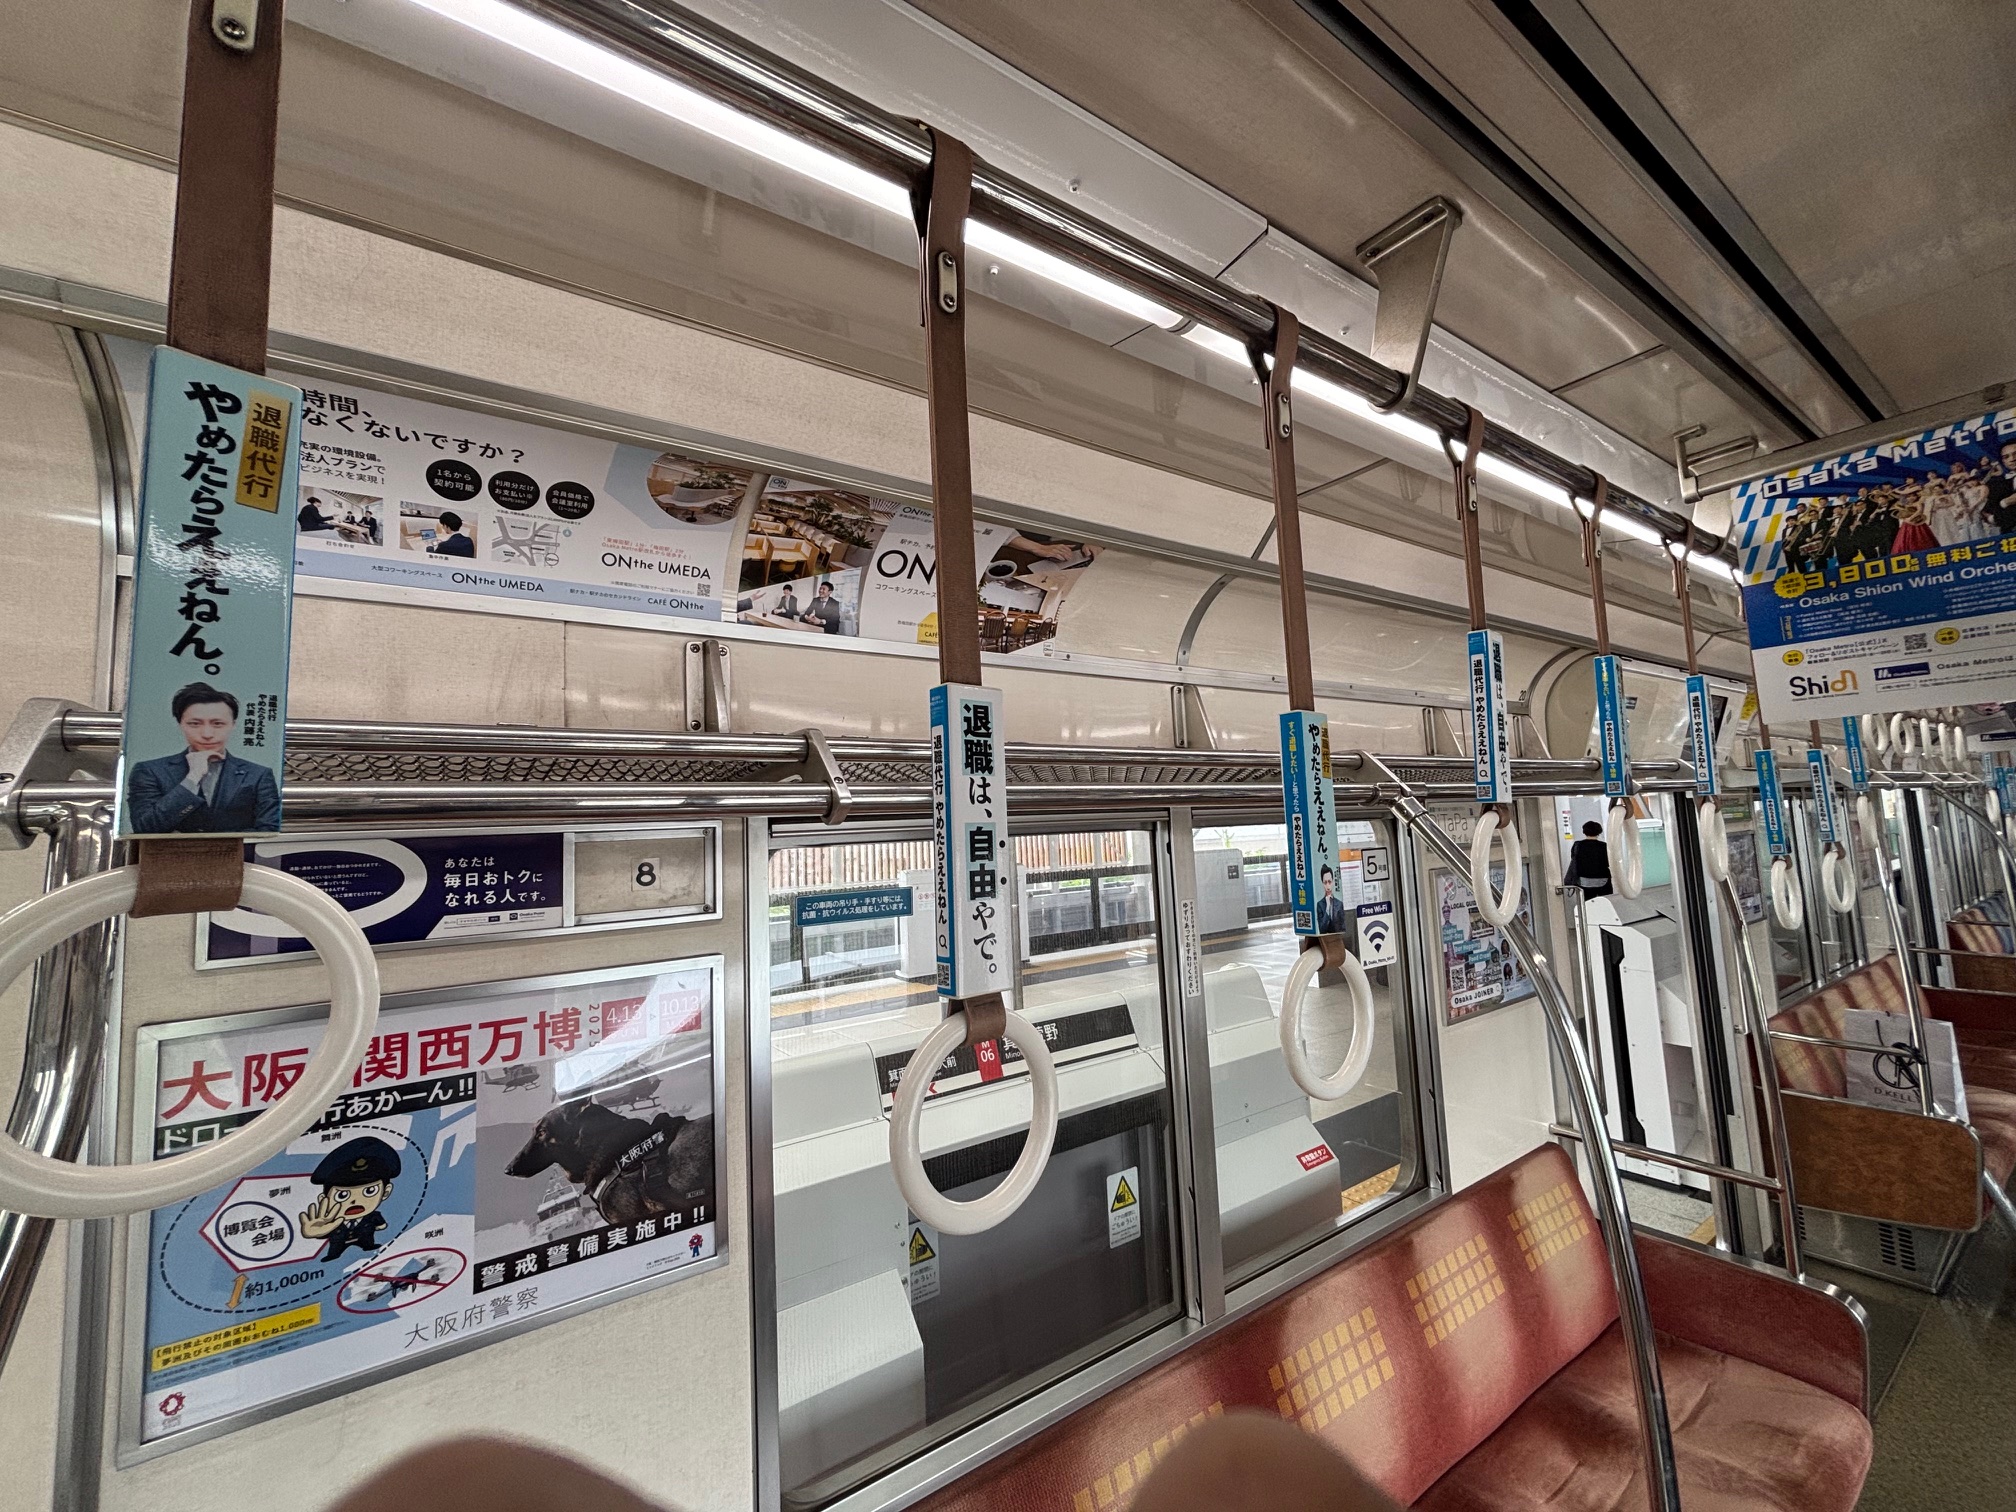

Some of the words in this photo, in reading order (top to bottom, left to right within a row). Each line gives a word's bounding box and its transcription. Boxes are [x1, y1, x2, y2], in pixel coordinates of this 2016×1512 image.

[242, 402, 283, 498] 退職代行
[437, 468, 472, 481] 1名から
[495, 479, 535, 491] 利用分だけ
[1762, 455, 1879, 499] Osaka
[433, 478, 475, 493] 契約可能
[552, 489, 589, 501] 会員価格で
[371, 565, 443, 578] 大型コワーキングスペース
[658, 561, 711, 579] UMEDA
[499, 578, 544, 592] UMEDA
[1799, 592, 1850, 608] Osaka
[1854, 582, 1903, 598] Shion
[1908, 571, 1954, 588] Wind
[1473, 659, 1484, 694] 退職代行
[1475, 696, 1488, 765] やめたらええねん
[933, 734, 944, 795] 退職代行
[1307, 723, 1328, 860] やめたらええねん。
[963, 703, 998, 974] 退職は、自由やで。
[1293, 816, 1305, 879] やめたらええねん
[444, 856, 495, 869] あなたは
[935, 801, 948, 925] やめたらええねん
[443, 869, 543, 888] 毎日おトクに
[636, 862, 656, 887] 8
[444, 888, 546, 907] なれる人です。
[1361, 906, 1374, 915] Free
[1373, 904, 1388, 913] Wi-Fi
[1182, 902, 1194, 995] ゆずりあっておすわりください
[1454, 993, 1473, 1005] Osaka
[606, 1004, 642, 1024] 4.13
[161, 1008, 582, 1119] 大阪関西万博
[980, 1050, 995, 1063] 06
[268, 1186, 291, 1198] 夢洲
[223, 1215, 275, 1238] 博覧会
[251, 1228, 286, 1247] 会場
[244, 1269, 325, 1299] 約1,000m
[405, 1286, 540, 1350] 大阪府警察
